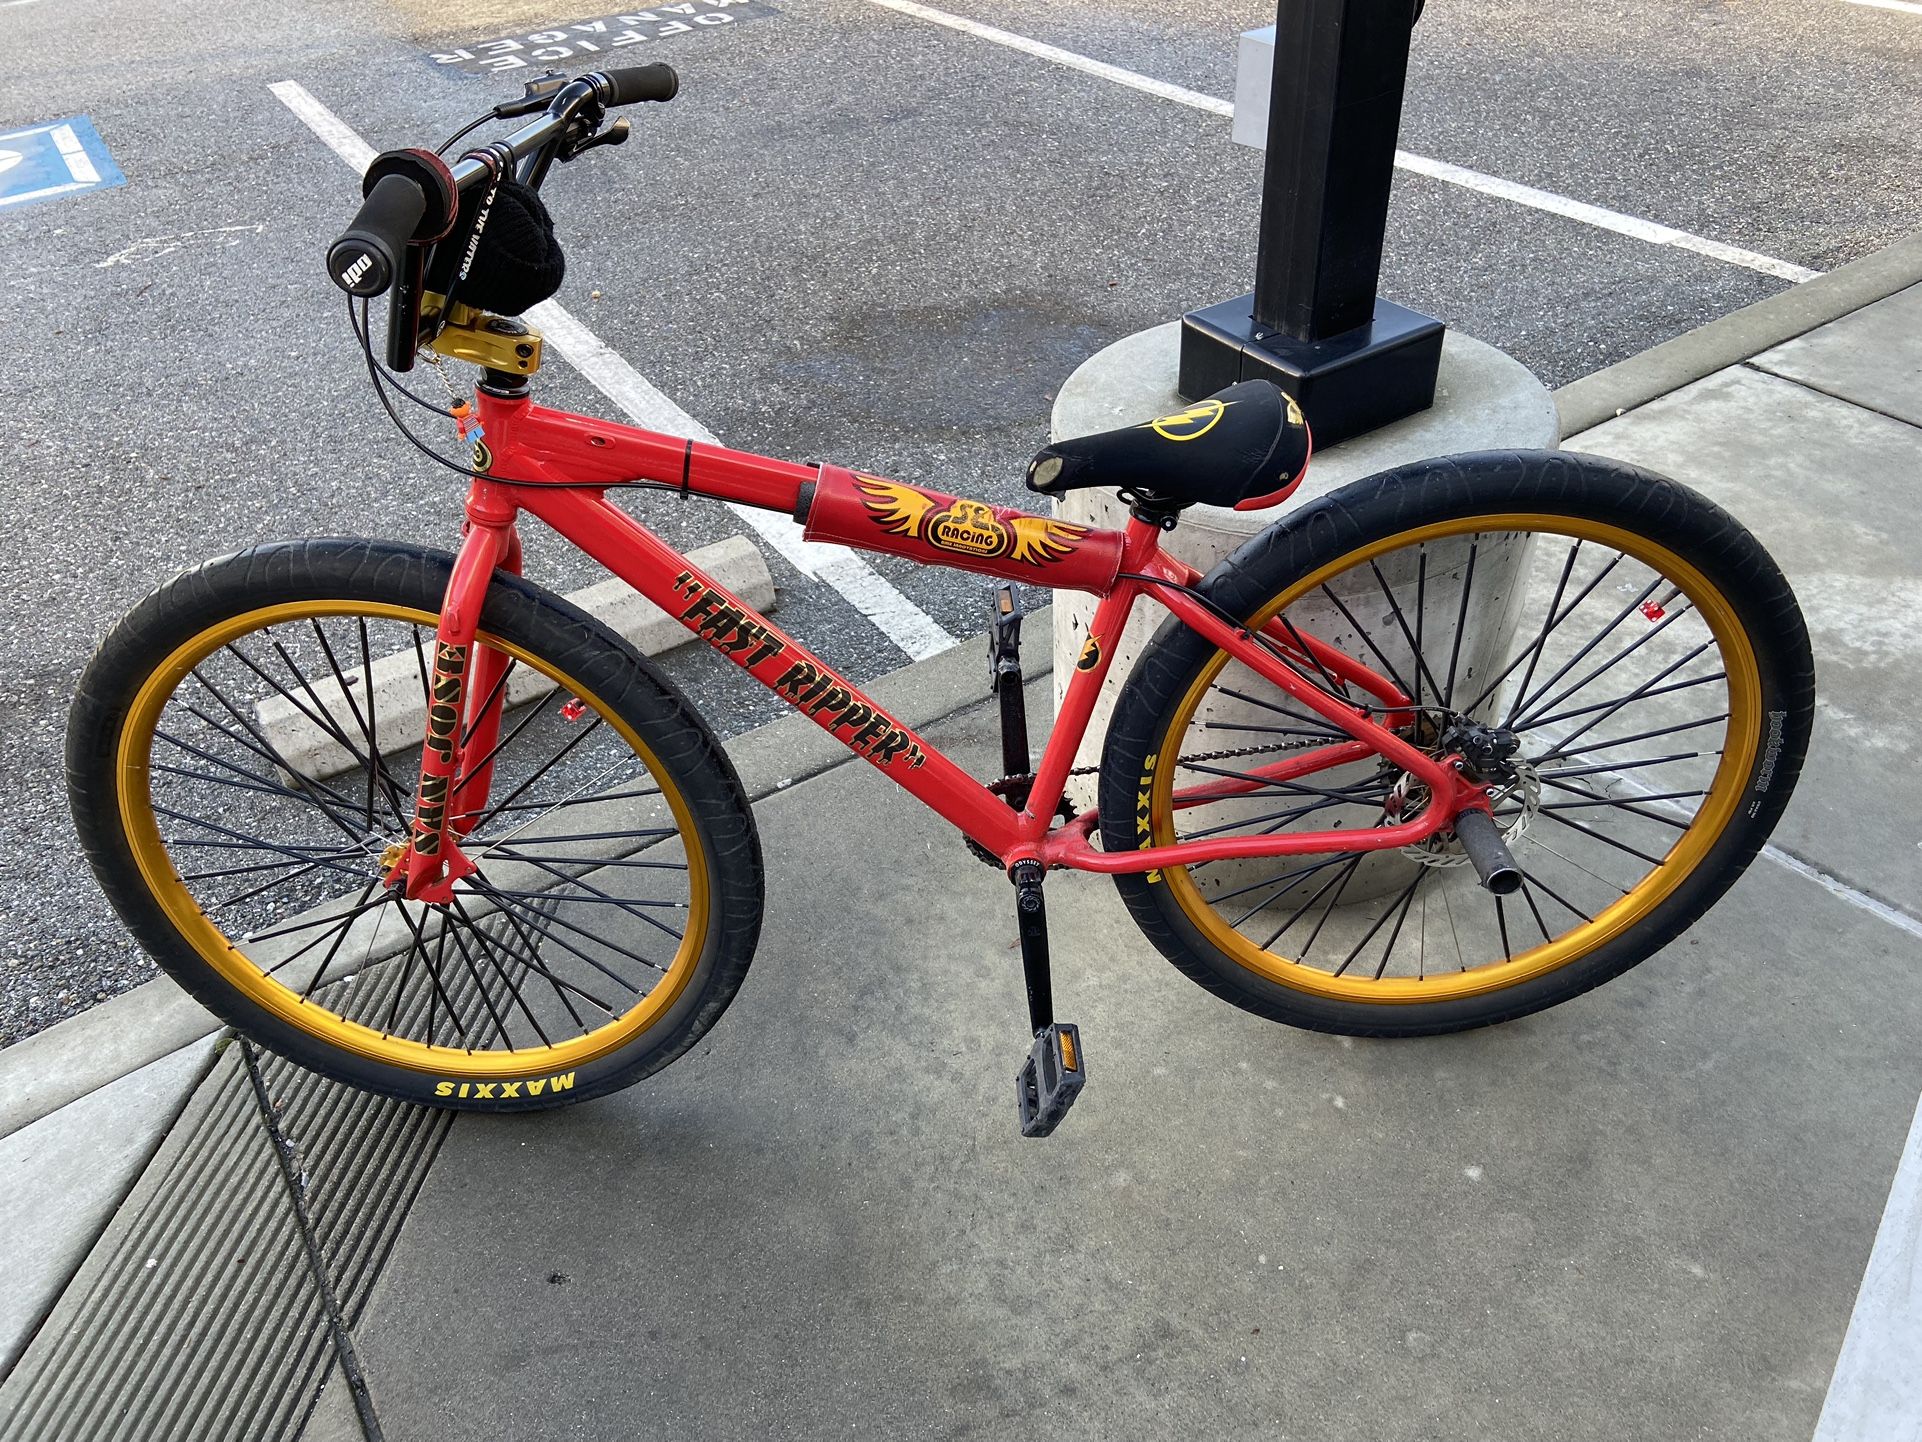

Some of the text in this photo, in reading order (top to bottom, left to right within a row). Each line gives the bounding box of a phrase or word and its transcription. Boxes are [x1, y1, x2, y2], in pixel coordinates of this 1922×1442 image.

[478, 12, 735, 72] OFFICE
[486, 186, 498, 206] TO
[414, 641, 468, 856] SAN JOSE
[434, 1071, 576, 1099] MAXXIS
